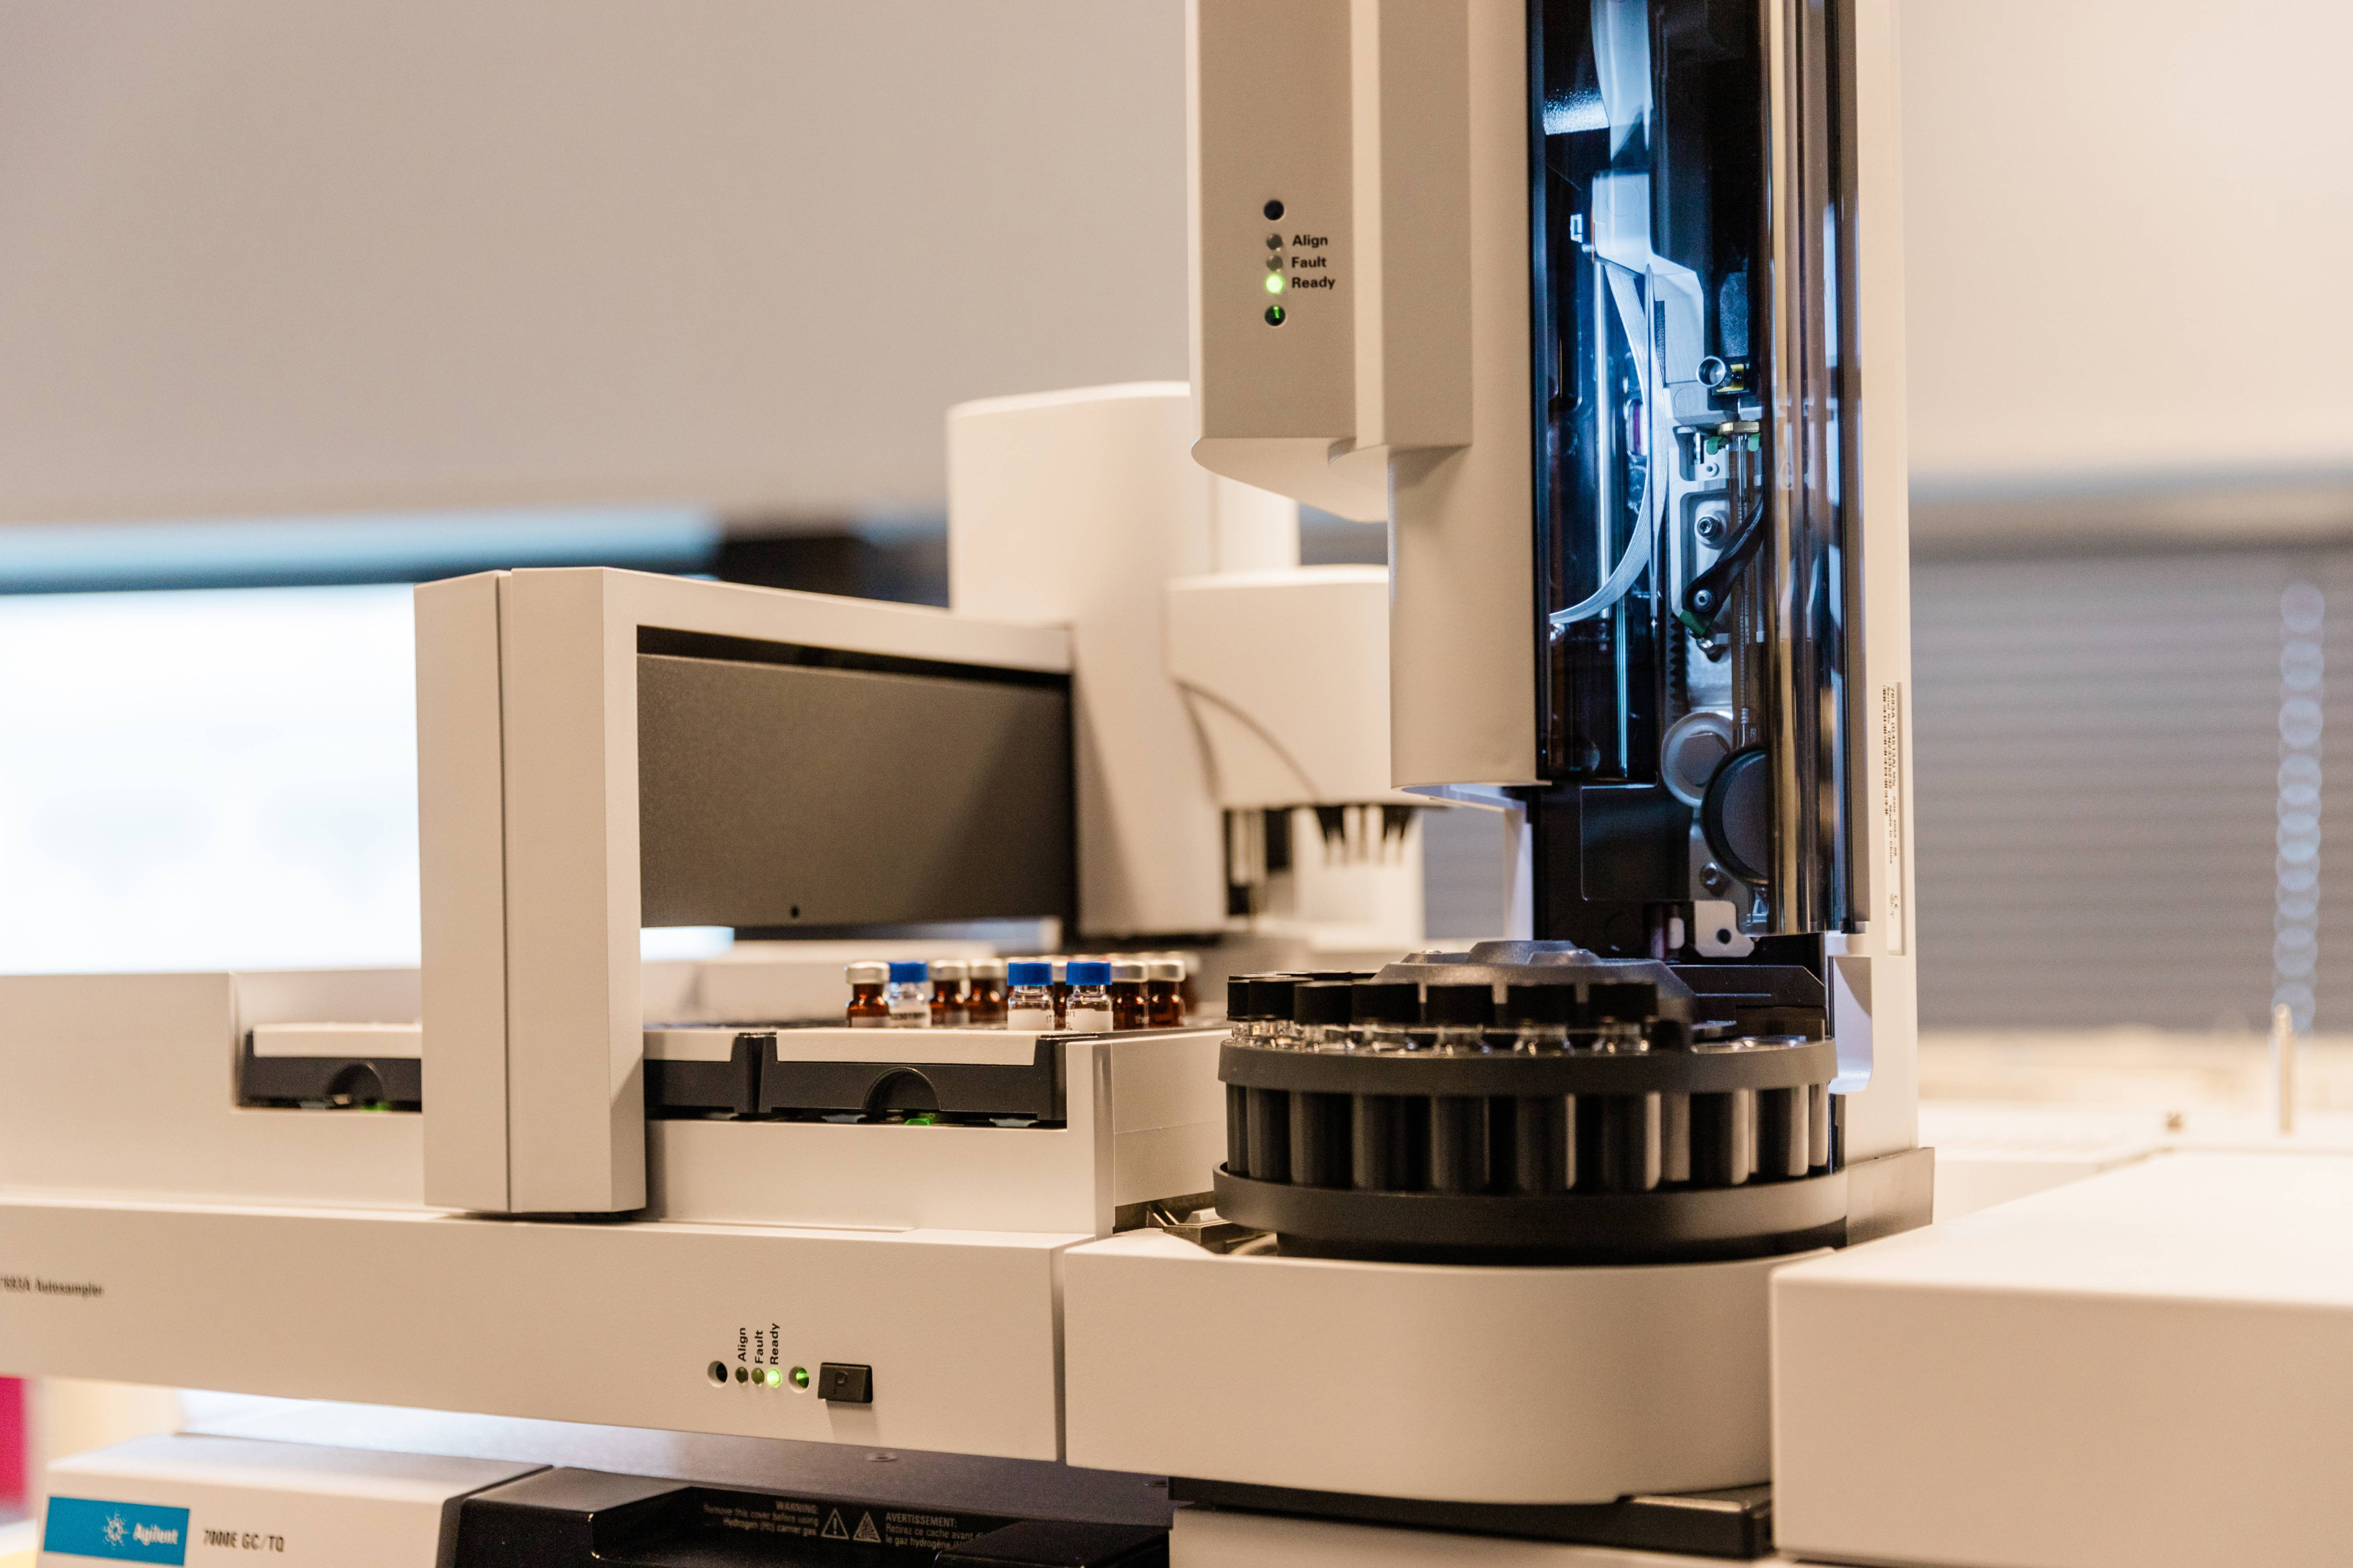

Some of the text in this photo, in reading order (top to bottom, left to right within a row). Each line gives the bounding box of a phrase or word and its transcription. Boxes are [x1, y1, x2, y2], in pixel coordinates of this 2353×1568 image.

[1292, 235, 1328, 248] Align
[1291, 256, 1327, 268] Fault
[1291, 276, 1335, 290] Ready
[738, 1327, 749, 1362] Align
[754, 1330, 763, 1364] Fault
[770, 1323, 780, 1365] Ready
[886, 1512, 957, 1528] AVERTISSEMENT:
[133, 1522, 179, 1546] Agilent
[885, 1522, 912, 1535] Retirez
[926, 1528, 950, 1539] cache
[951, 1532, 974, 1540] avant
[885, 1534, 893, 1544] le
[894, 1537, 908, 1547] gaz
